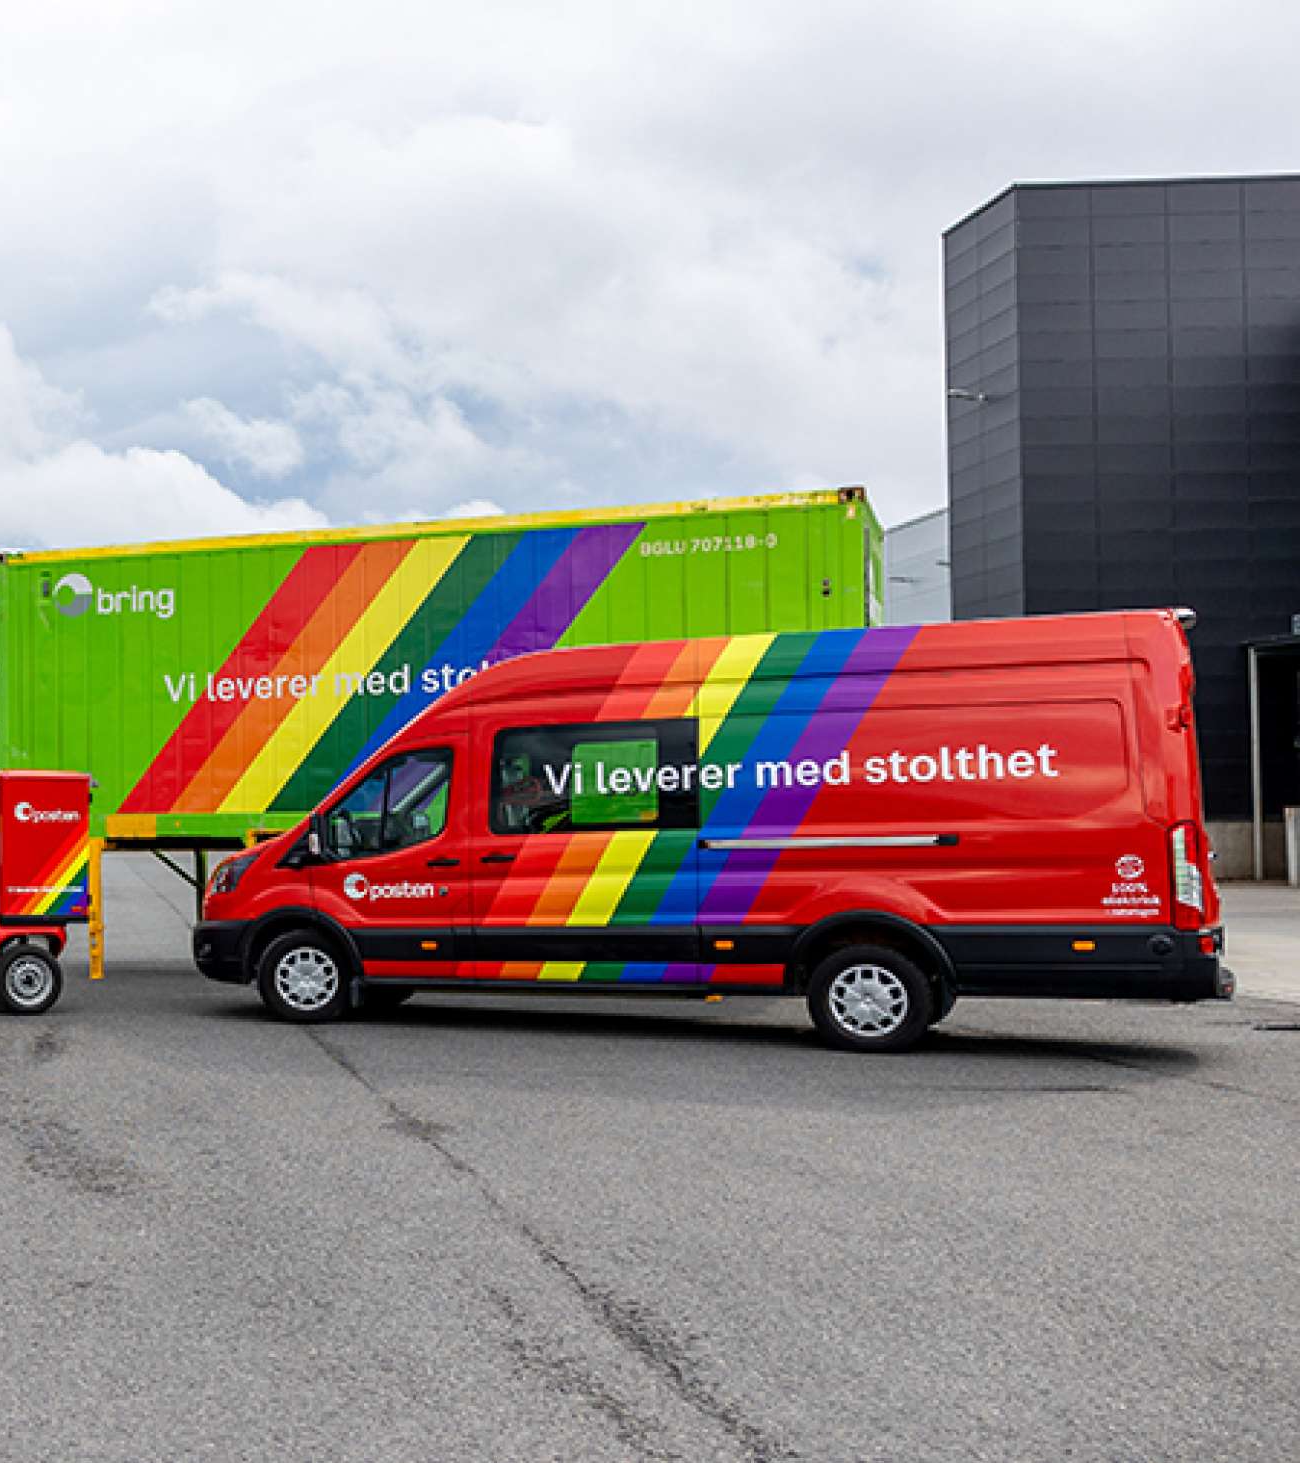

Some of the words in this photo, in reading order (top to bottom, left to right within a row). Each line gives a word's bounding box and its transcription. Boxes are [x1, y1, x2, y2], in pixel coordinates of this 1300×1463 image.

[97, 585, 175, 619] bring
[163, 672, 196, 703] Vi
[206, 672, 318, 703] leverer
[333, 663, 412, 697] med
[545, 763, 583, 796] Vi
[596, 756, 741, 796] leverer
[755, 750, 851, 788] med
[863, 743, 1059, 785] stolthet
[369, 881, 434, 902] posten
